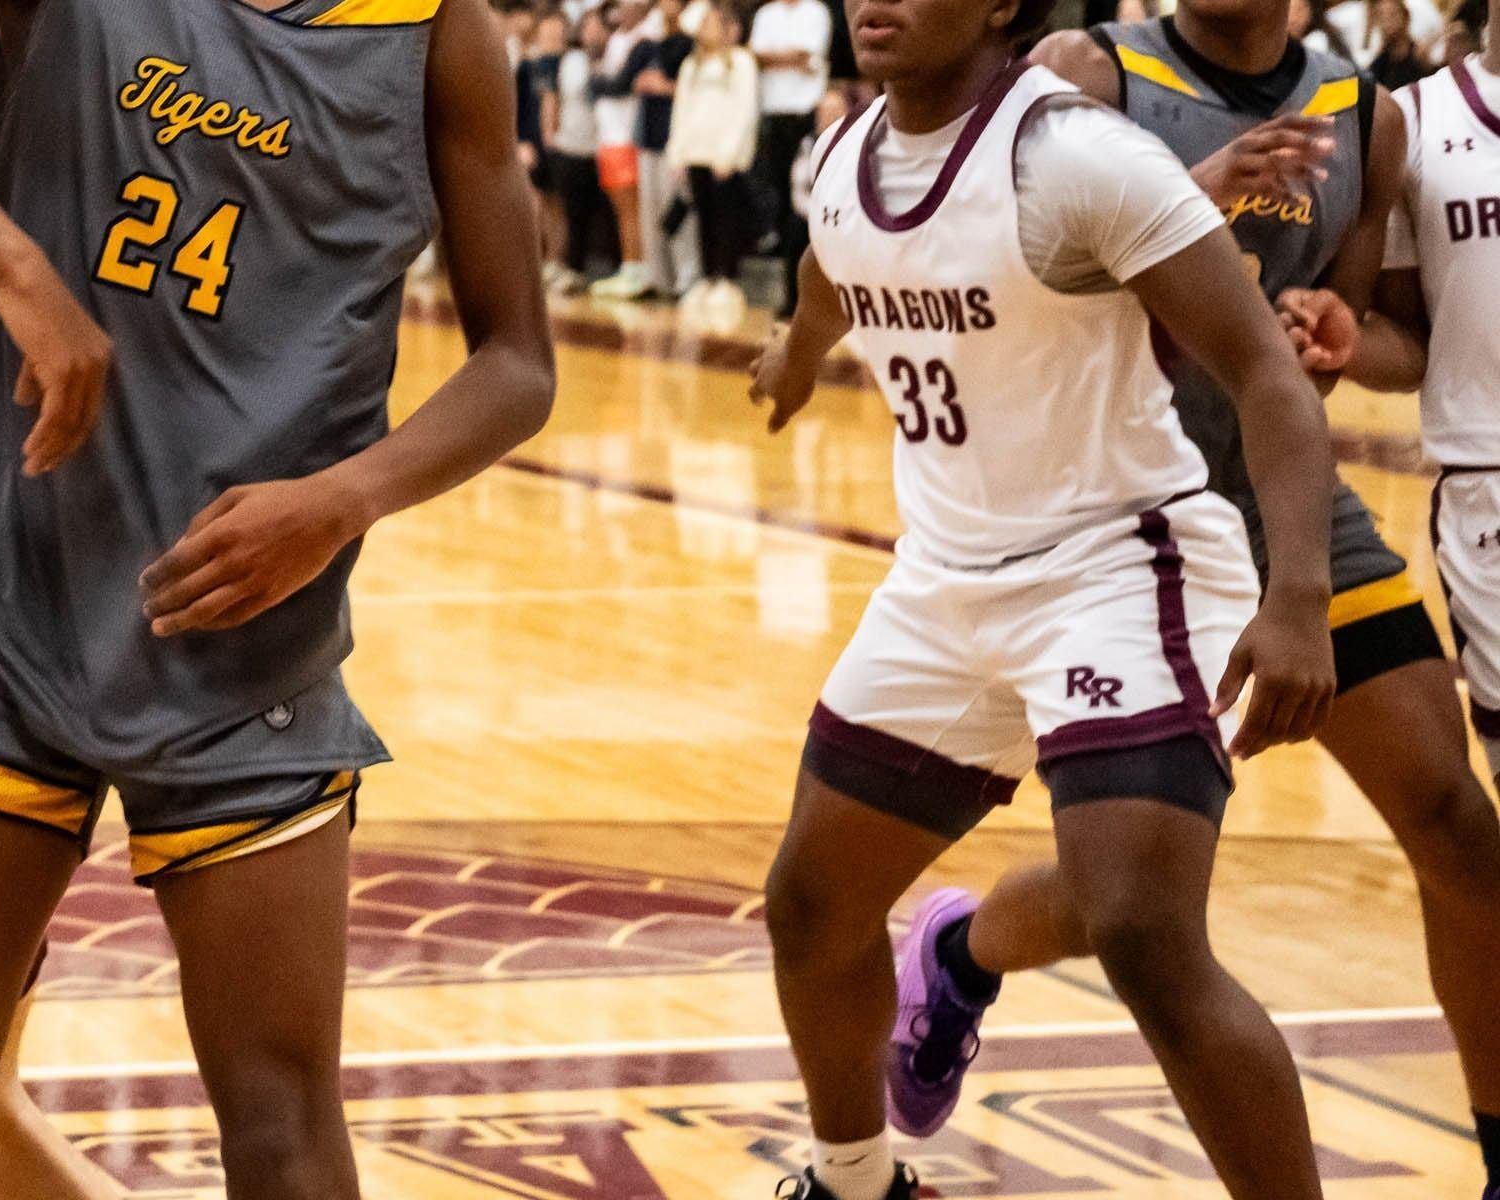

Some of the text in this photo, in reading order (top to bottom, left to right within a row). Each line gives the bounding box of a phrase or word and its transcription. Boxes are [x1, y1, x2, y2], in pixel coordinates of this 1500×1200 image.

[117, 55, 294, 158] Tigers
[92, 171, 246, 320] 24
[836, 282, 997, 334] DRAGONS
[888, 355, 968, 447] 33
[1065, 665, 1124, 709] RR
